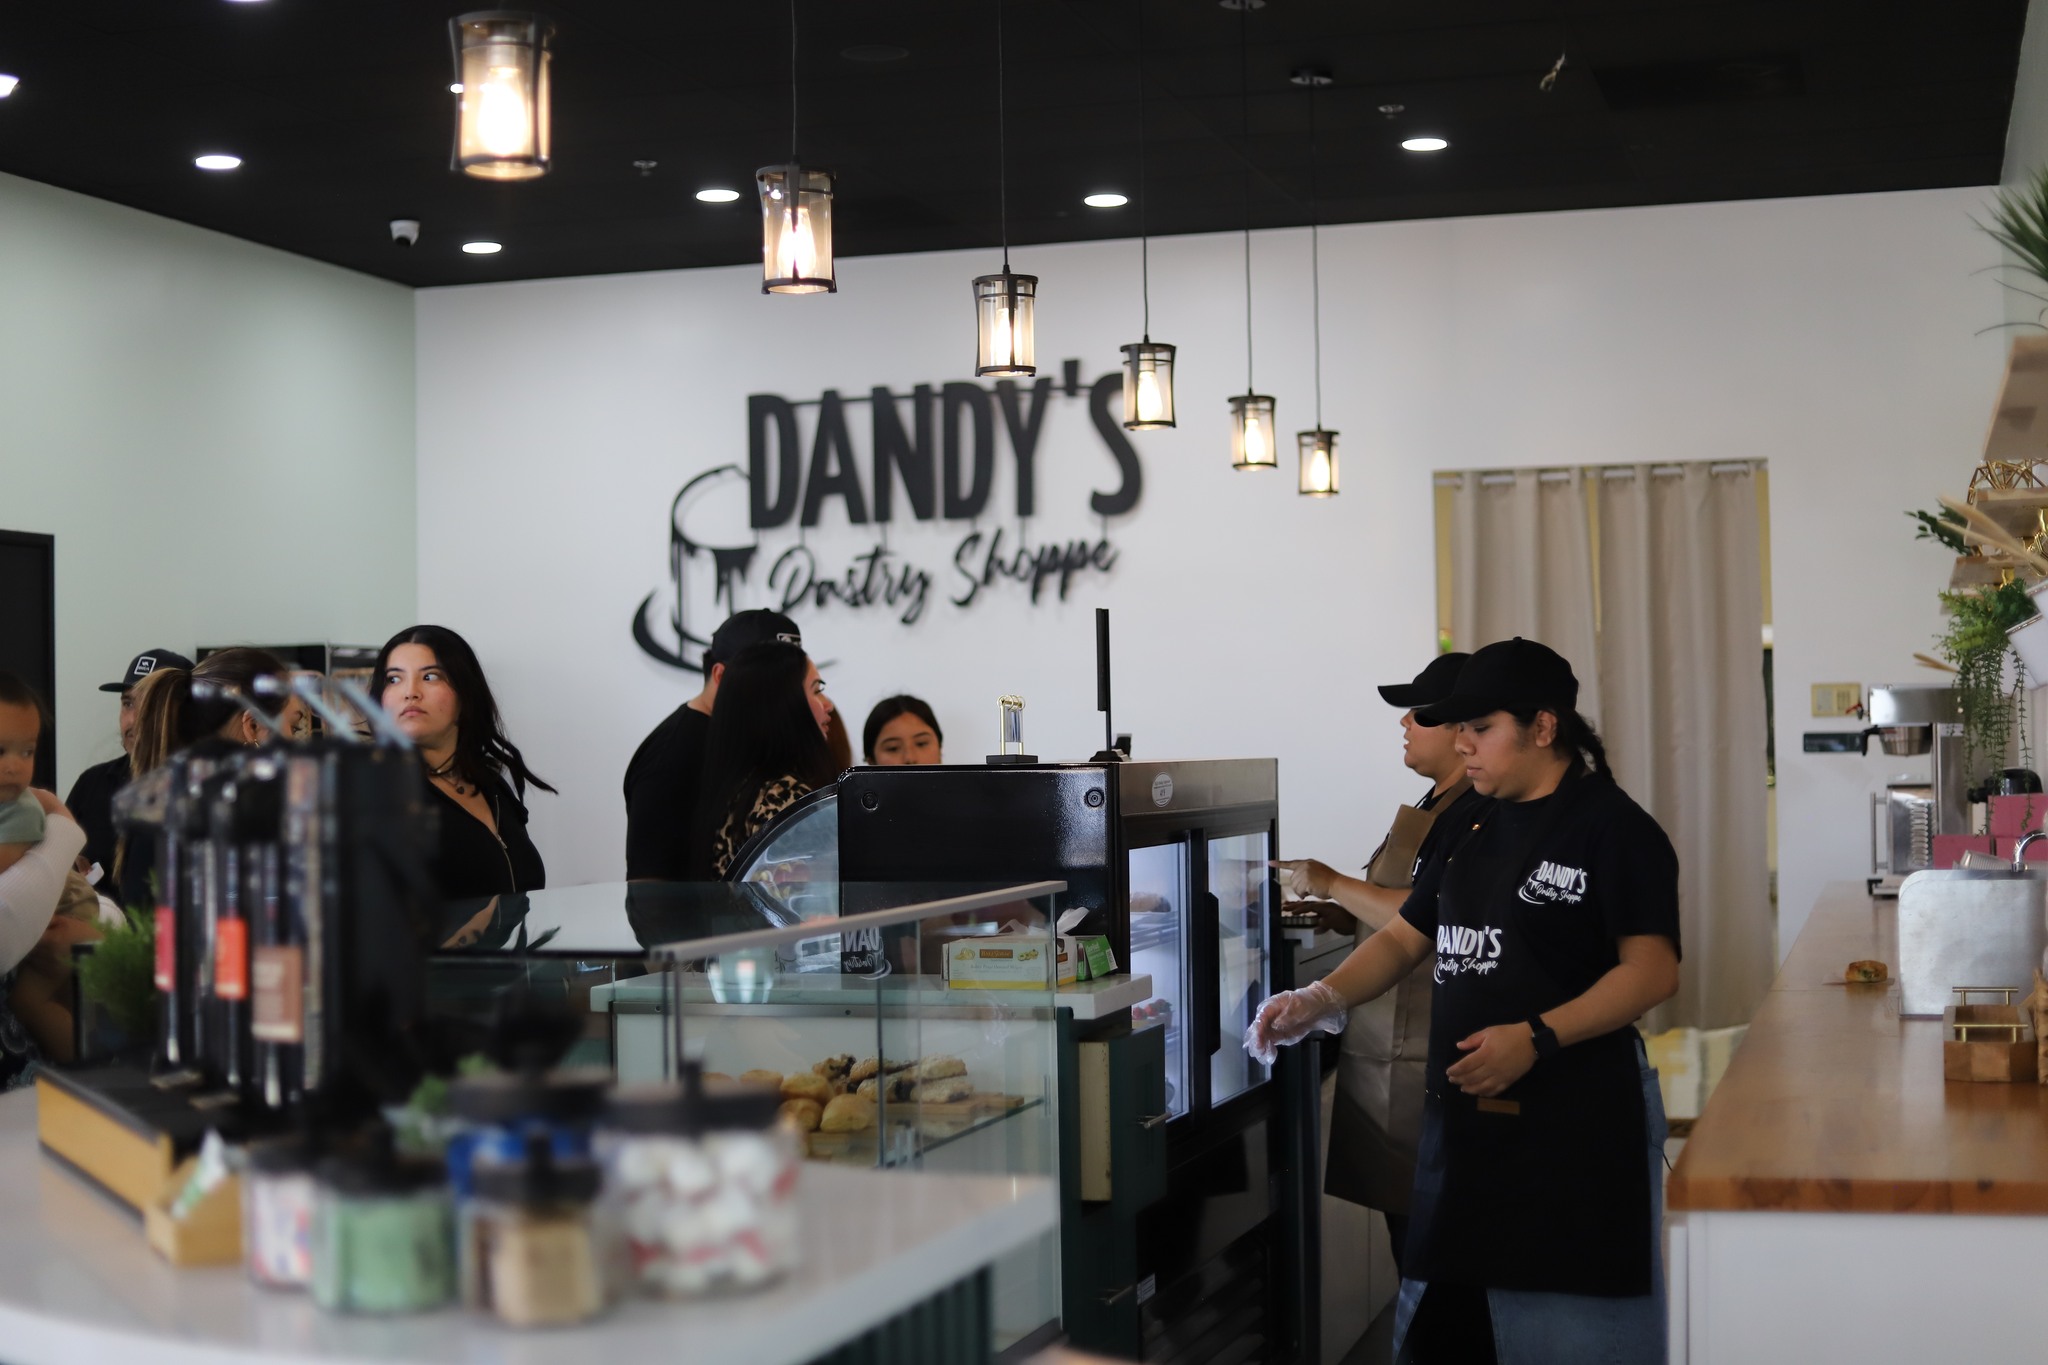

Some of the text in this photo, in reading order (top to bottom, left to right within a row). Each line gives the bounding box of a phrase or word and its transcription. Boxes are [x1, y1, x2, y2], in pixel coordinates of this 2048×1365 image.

[748, 360, 1142, 530] DANDY'S
[769, 527, 1118, 624] Pastry Shoppe
[1536, 860, 1588, 894] DANDY'S
[1536, 884, 1582, 904] Pastry Shoppe
[1436, 925, 1502, 959] DANDY'S
[1460, 957, 1498, 975] Shoppe
